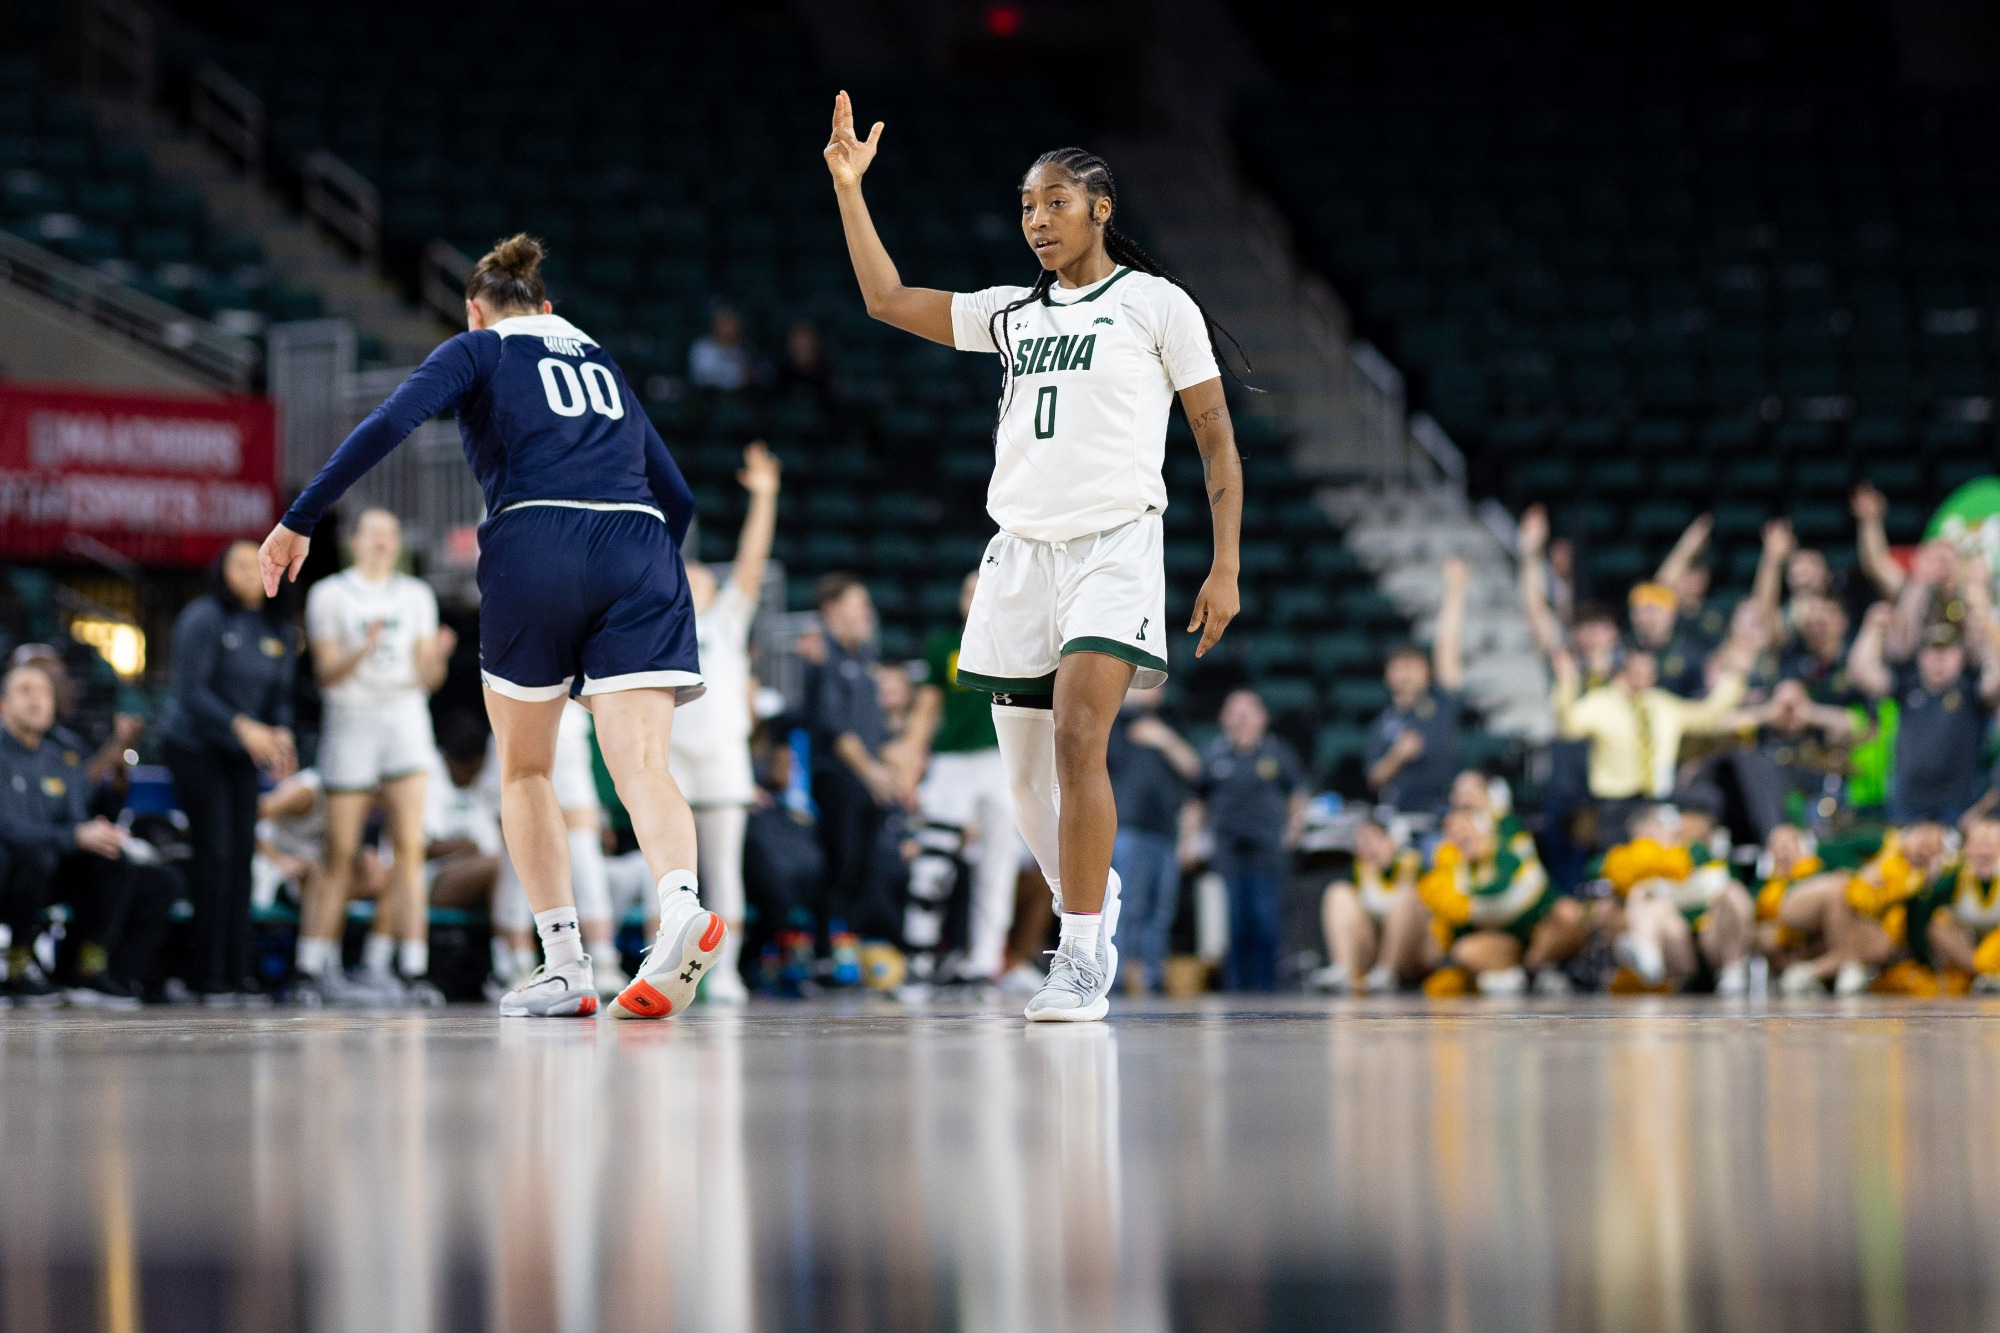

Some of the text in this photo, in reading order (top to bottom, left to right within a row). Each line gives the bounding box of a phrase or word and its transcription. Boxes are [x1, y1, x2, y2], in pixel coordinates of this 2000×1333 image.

[1013, 333, 1097, 377] SIENA
[537, 357, 625, 420] 00
[1034, 385, 1057, 440] 0
